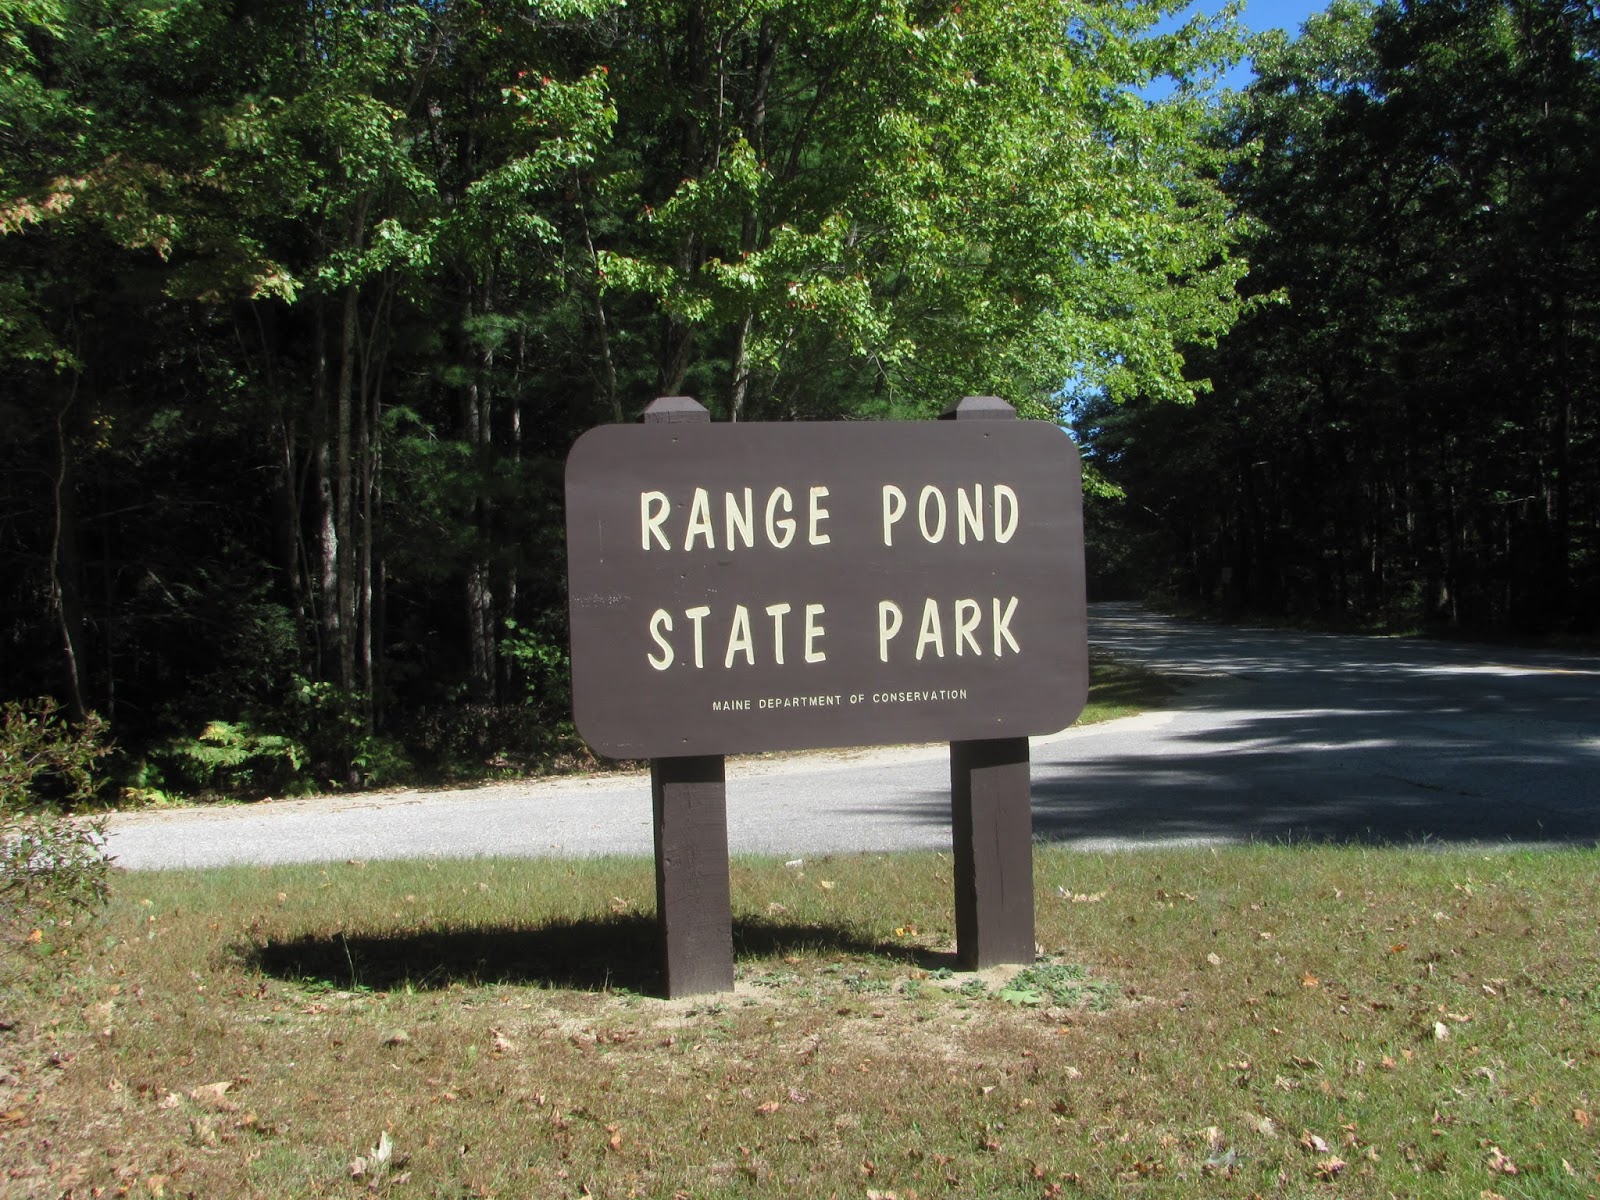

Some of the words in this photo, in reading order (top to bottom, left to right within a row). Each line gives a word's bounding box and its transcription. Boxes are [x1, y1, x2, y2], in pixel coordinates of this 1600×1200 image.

[640, 485, 831, 552] RANGE
[882, 483, 1019, 547] POND
[647, 603, 827, 671] STATE
[878, 595, 1021, 663] PARK
[712, 699, 751, 711] MAINE
[758, 695, 842, 709] DEPARTMENT
[849, 693, 865, 705] OF
[872, 688, 967, 704] CONSERVATION
